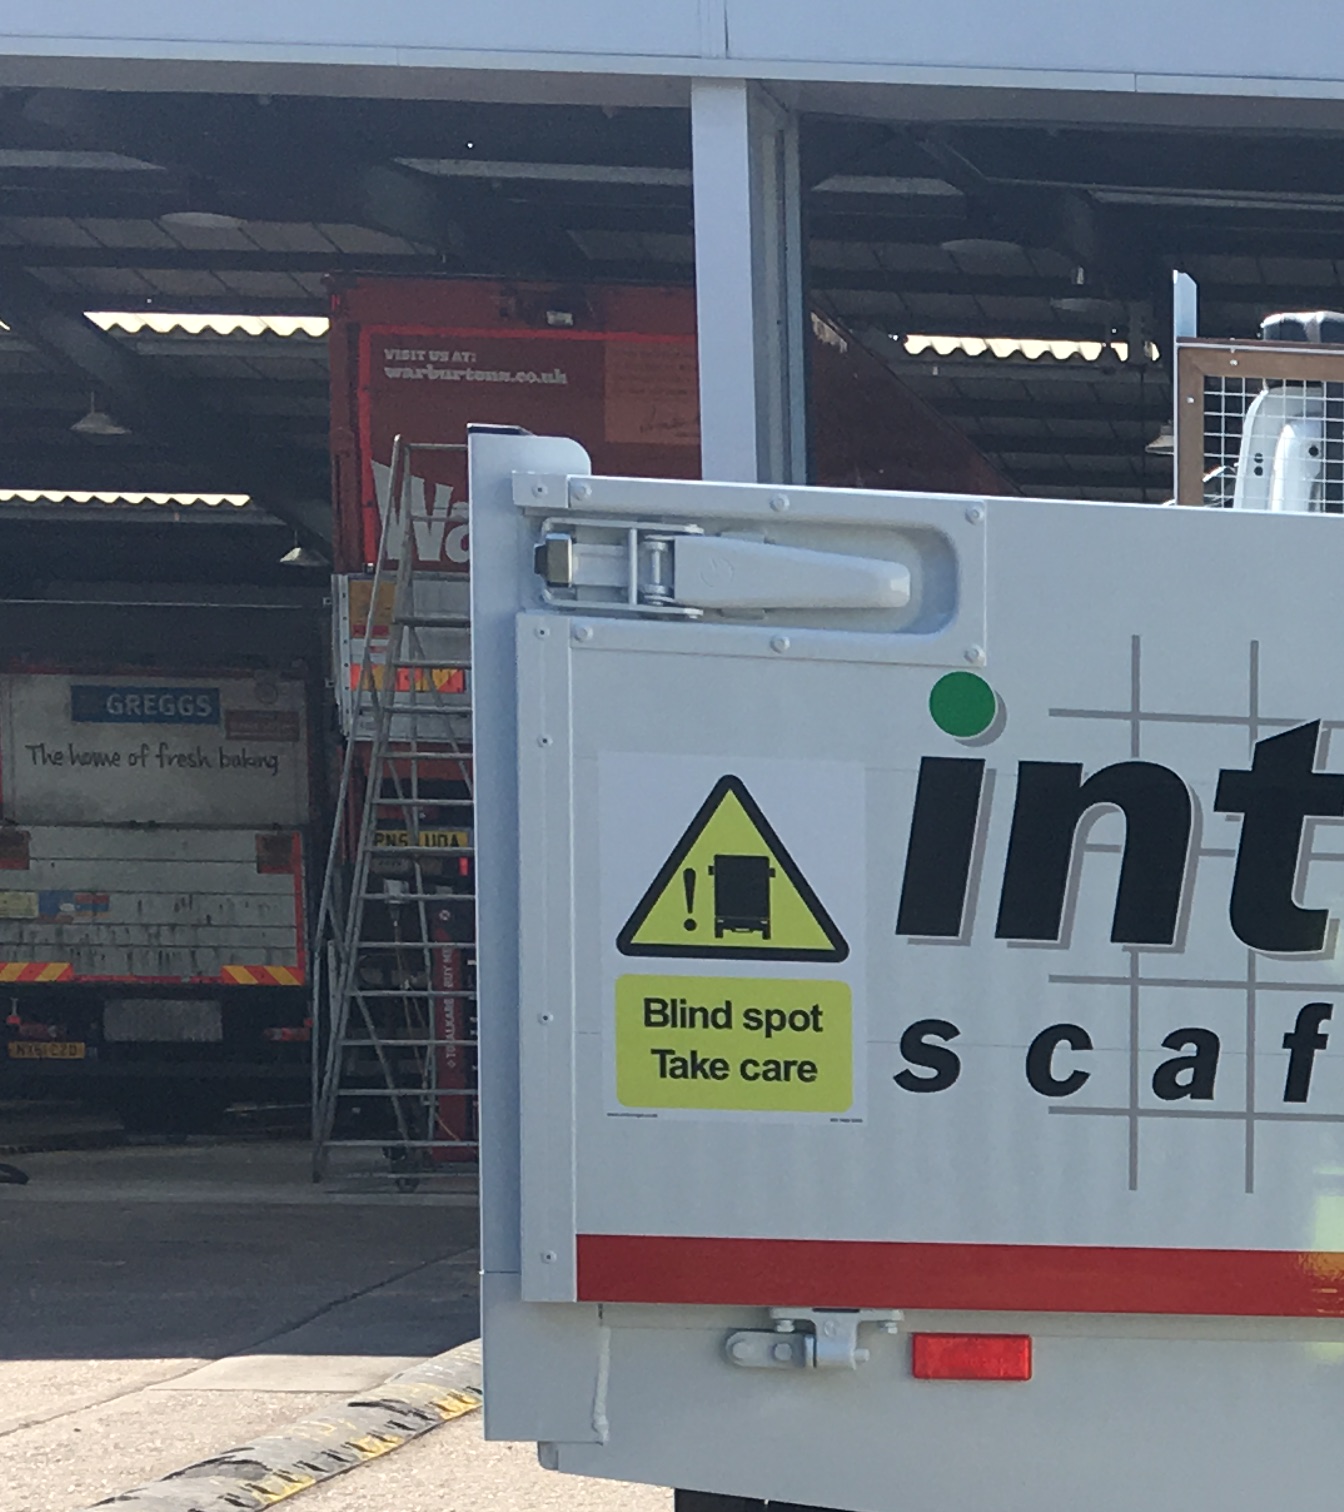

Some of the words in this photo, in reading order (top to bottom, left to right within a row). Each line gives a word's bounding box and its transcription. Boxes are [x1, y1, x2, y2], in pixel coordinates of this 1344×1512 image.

[384, 364, 568, 384] warburtons.co.uk
[106, 693, 213, 717] GREGGS
[25, 743, 63, 766] The
[70, 743, 121, 767] home
[129, 743, 150, 768] of
[156, 742, 213, 769] fresh
[218, 745, 279, 776] baking
[643, 997, 733, 1030] Blind
[742, 1004, 824, 1039] spot
[650, 1048, 730, 1081] Take
[739, 1058, 818, 1083] care
